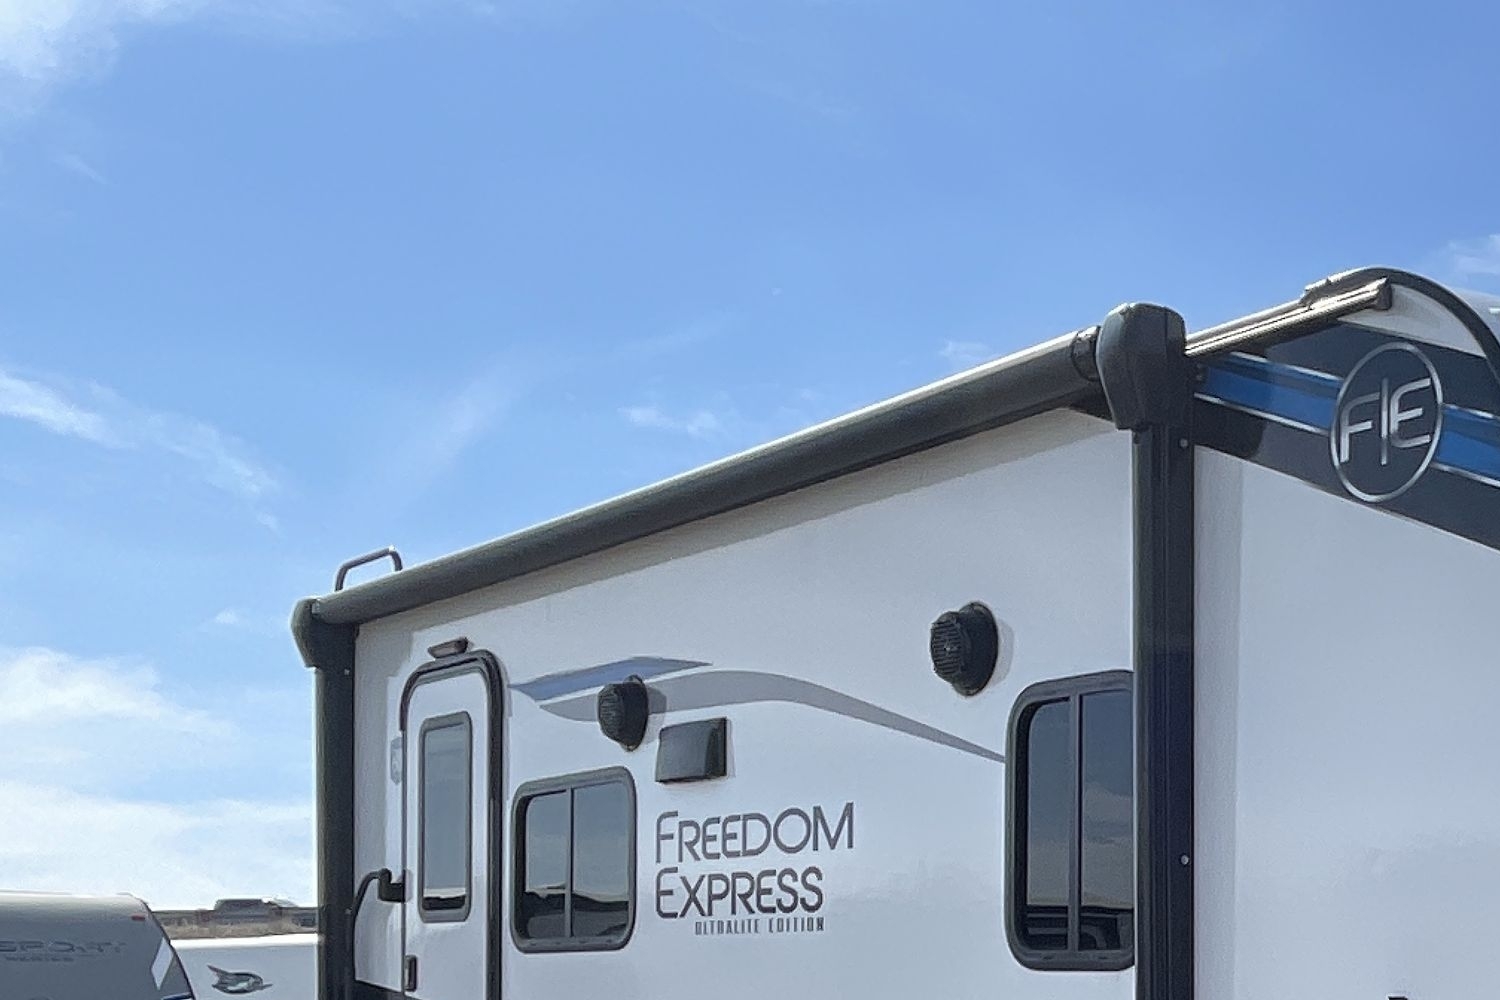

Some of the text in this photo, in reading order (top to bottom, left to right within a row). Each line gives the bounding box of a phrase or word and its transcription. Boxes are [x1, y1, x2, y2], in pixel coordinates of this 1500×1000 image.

[655, 801, 855, 863] FREEDOM
[655, 866, 824, 919] EXPRESS
[768, 916, 825, 933] EDITION
